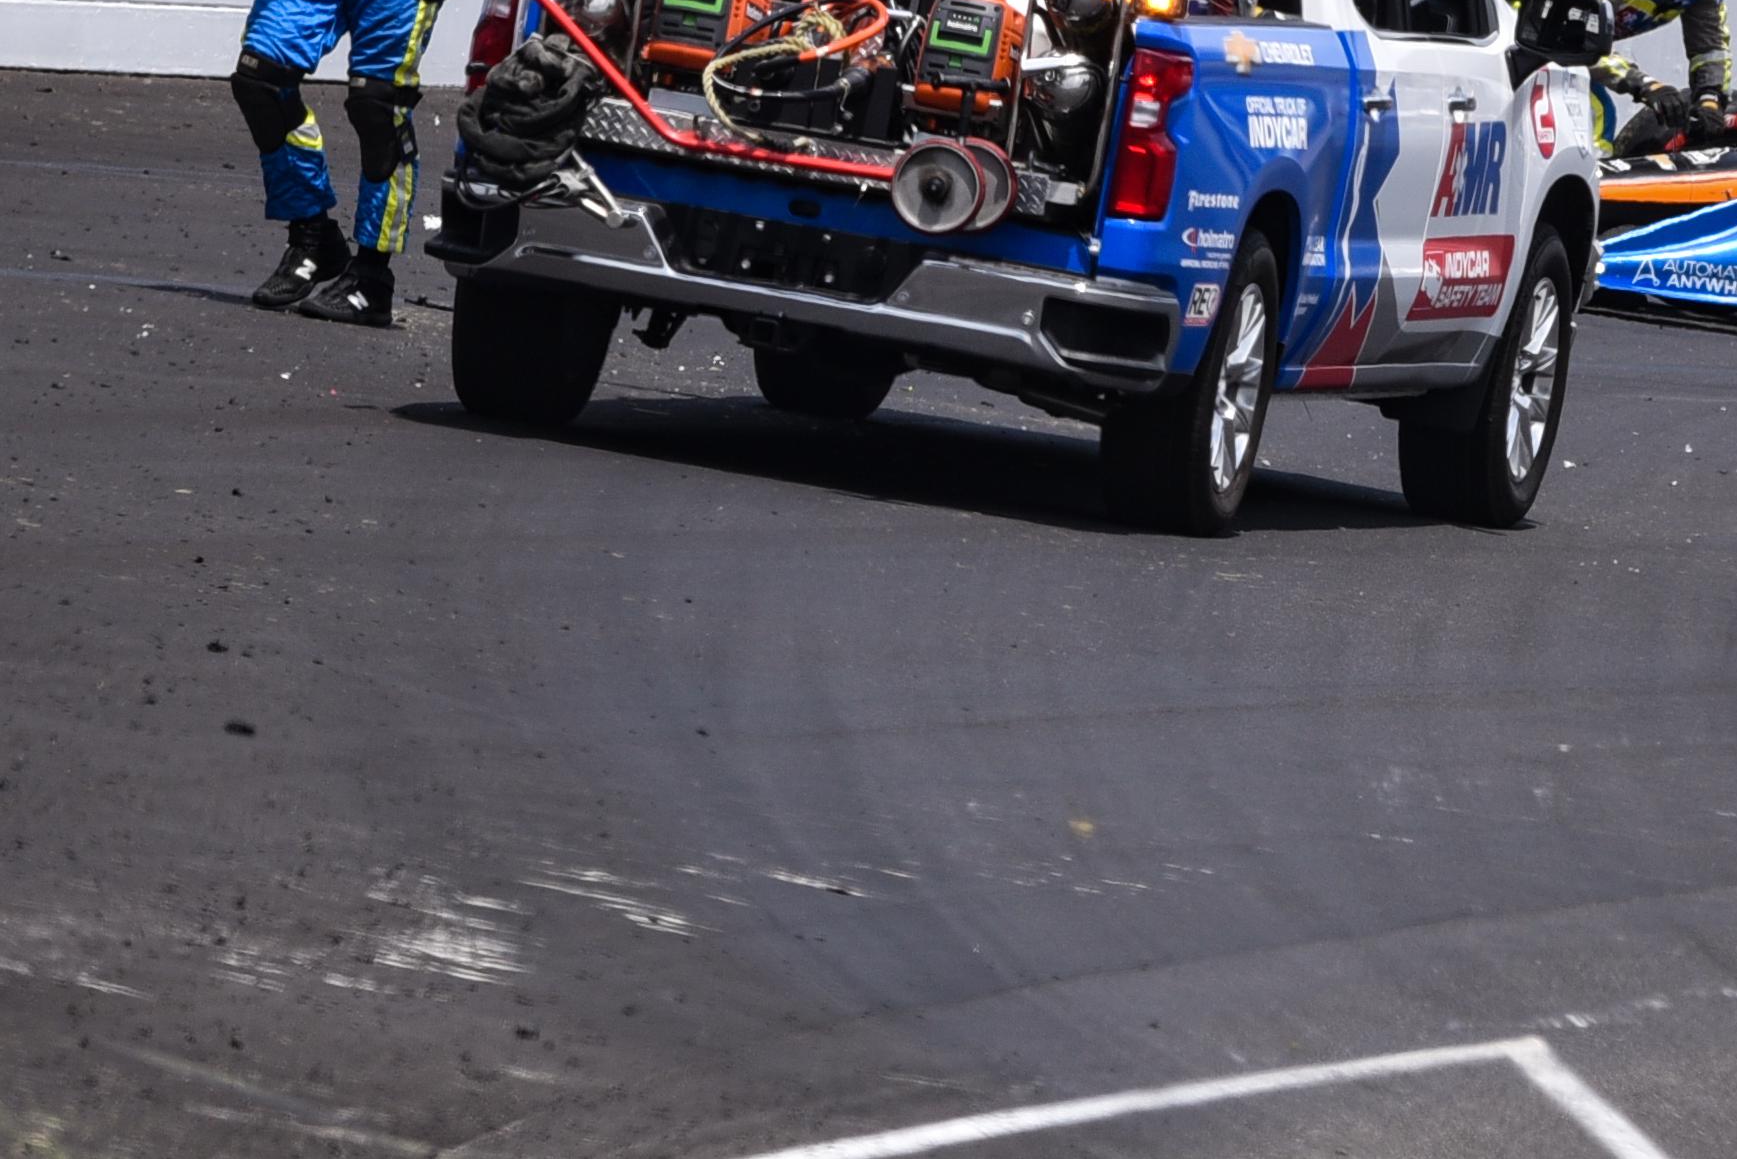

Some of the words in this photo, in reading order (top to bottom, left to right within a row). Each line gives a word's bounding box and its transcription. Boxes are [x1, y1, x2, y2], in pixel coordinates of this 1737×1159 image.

[1259, 41, 1315, 66] CHEVROLET
[1245, 95, 1275, 114] OFFICIAL
[1248, 114, 1308, 150] INDYCAR
[1430, 121, 1507, 217] AMR
[1188, 190, 1240, 212] Firestone
[1444, 250, 1491, 280] INDYCAR
[1436, 285, 1475, 310] SAFETY
[1471, 283, 1503, 308] TEAM
